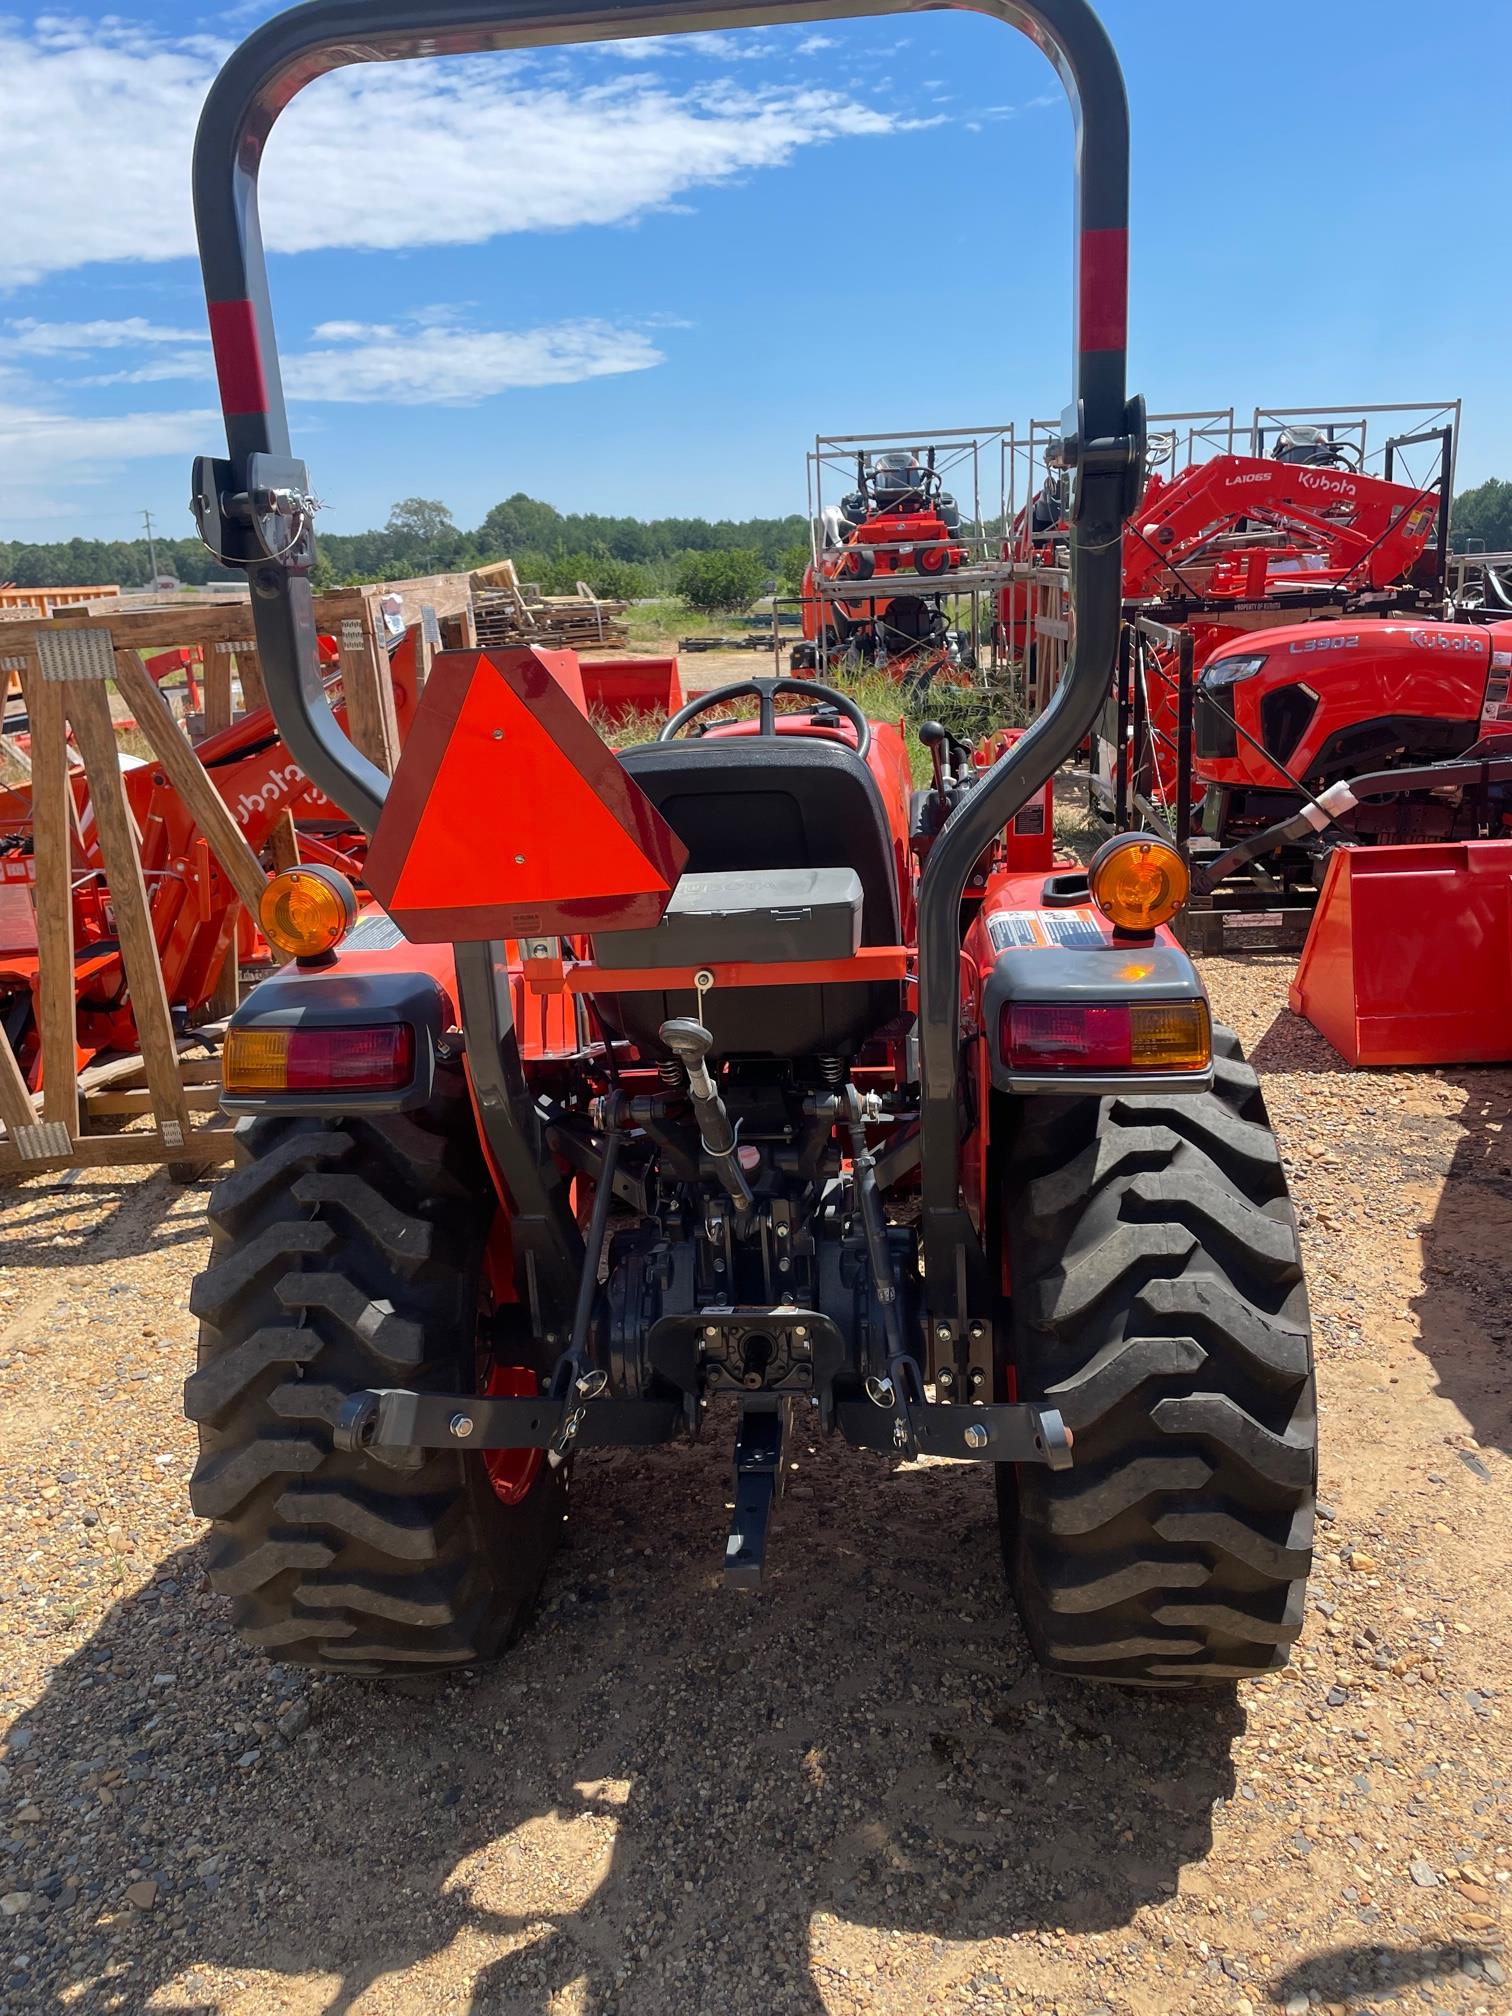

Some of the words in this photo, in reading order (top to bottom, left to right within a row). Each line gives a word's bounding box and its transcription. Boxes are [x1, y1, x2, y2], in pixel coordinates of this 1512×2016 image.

[1225, 472, 1273, 486] LA1065
[1298, 471, 1357, 496] Kubota
[1289, 635, 1360, 654] L3902
[1408, 630, 1484, 653] Kubota
[232, 764, 306, 825] ubota
